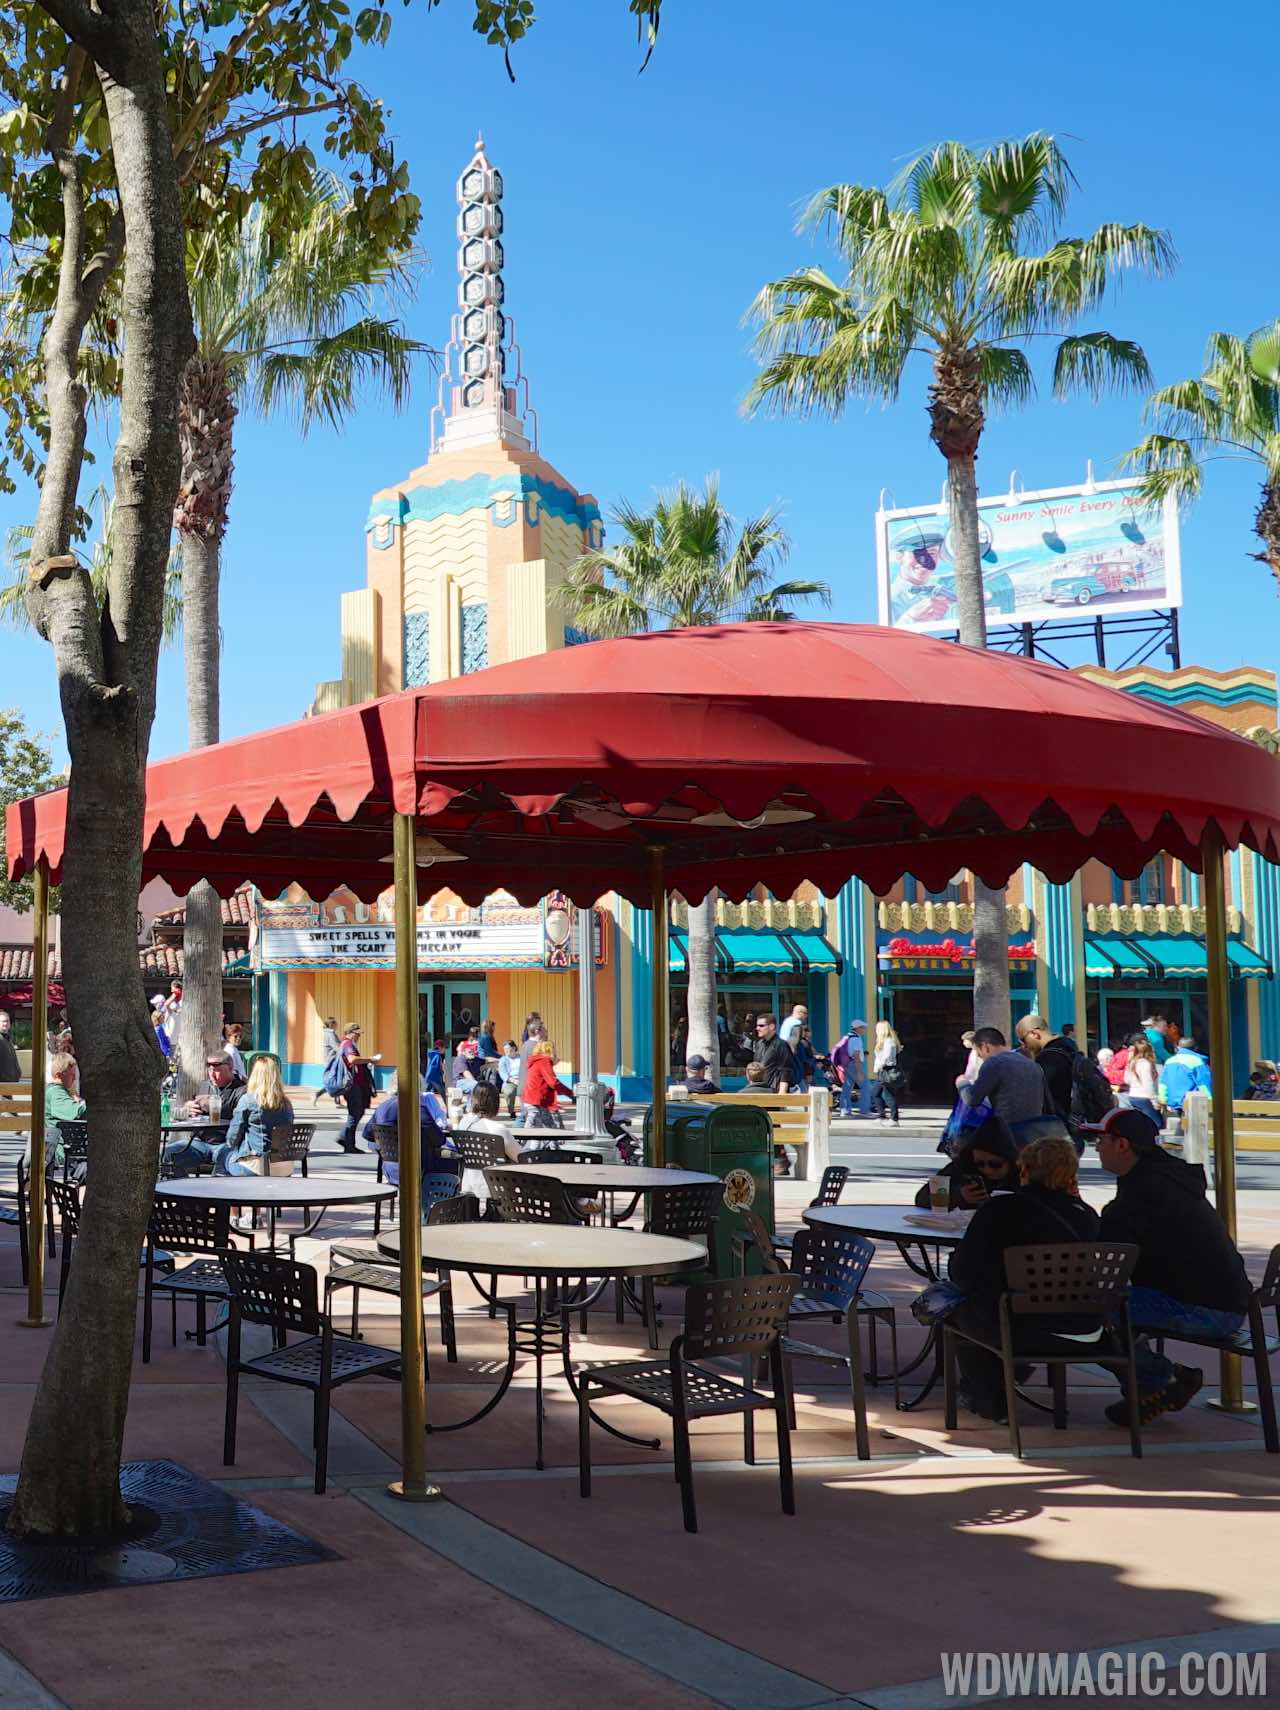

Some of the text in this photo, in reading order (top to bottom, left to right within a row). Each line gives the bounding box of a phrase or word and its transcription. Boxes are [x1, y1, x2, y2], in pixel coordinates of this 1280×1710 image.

[995, 510, 1035, 523] Sunny
[1080, 500, 1115, 513] Every
[334, 902, 463, 924] SUNET
[309, 931, 341, 941] SWEET
[345, 931, 380, 940] SPELLS
[331, 944, 348, 953] THE
[356, 943, 386, 953] SCARY
[891, 958, 950, 969] SWEET
